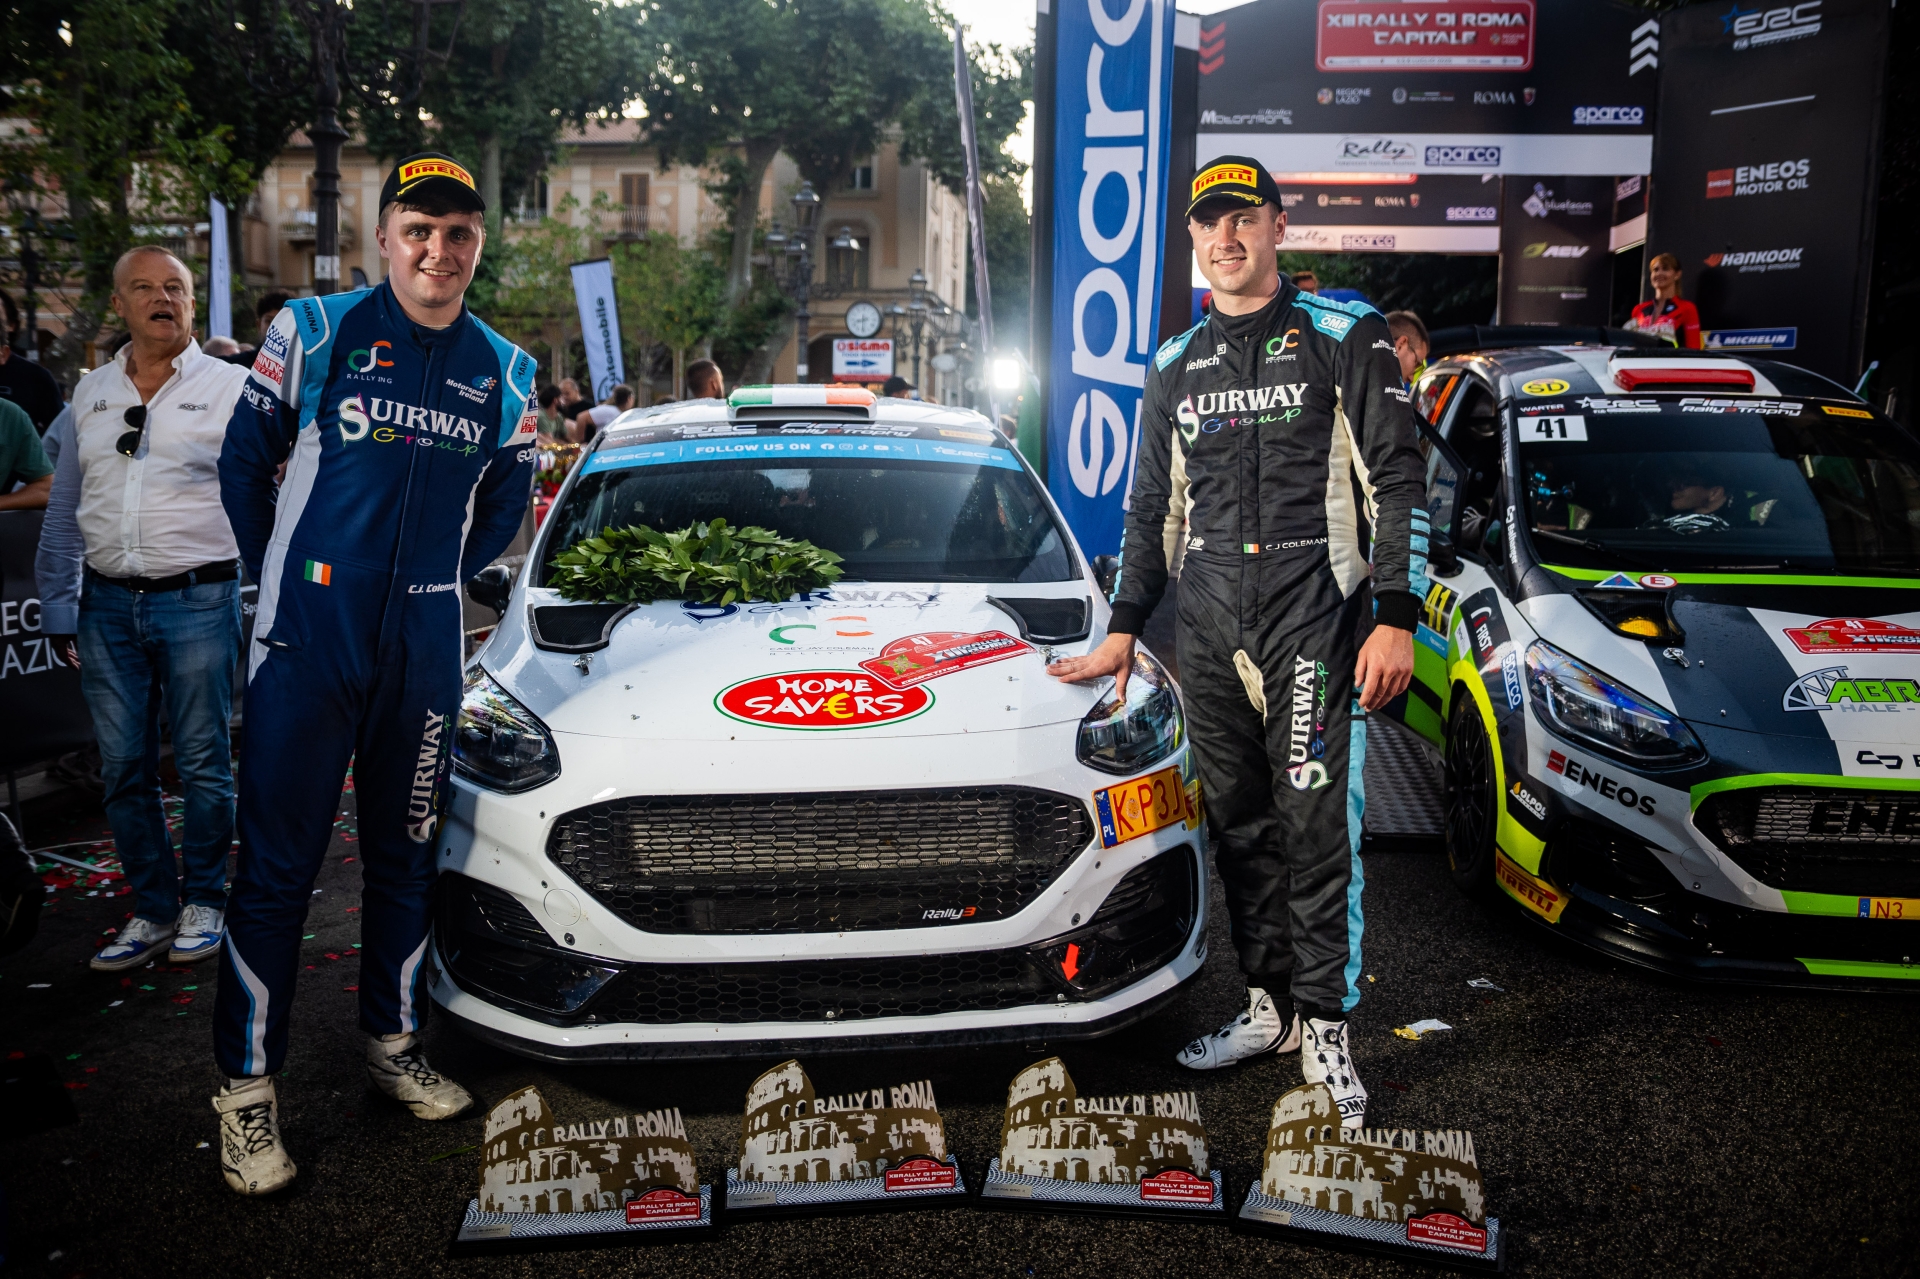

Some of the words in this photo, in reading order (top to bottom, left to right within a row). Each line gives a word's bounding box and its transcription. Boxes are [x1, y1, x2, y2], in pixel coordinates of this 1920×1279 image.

[1357, 13, 1430, 28] RALLY
[1436, 13, 1457, 27] DI
[1462, 13, 1526, 27] ROMA
[1373, 30, 1477, 46] CAPITALE
[1473, 91, 1515, 105] ROMA
[1573, 105, 1643, 126] sparco
[1343, 140, 1406, 160] Rally
[1425, 146, 1500, 166] sparco
[404, 163, 472, 187] PIRELLI
[1735, 159, 1811, 183] ENEOS
[1195, 171, 1253, 194] PIRELLI
[1735, 180, 1782, 197] MOTOR
[1786, 178, 1809, 190] OIL
[1374, 196, 1406, 207] ROMA
[1446, 206, 1498, 221] sparco
[1320, 316, 1349, 331] OMP
[1723, 334, 1789, 346] MICHELIN
[1157, 343, 1183, 364] OMP
[347, 373, 393, 386] RALLYING
[446, 378, 490, 399] Motorsport
[1527, 382, 1564, 394] SD
[458, 389, 488, 405] Ireland
[1679, 397, 1804, 410] Fiesta
[1176, 383, 1309, 448] SUIRWAY
[1519, 403, 1565, 414] WARTER
[1740, 407, 1801, 418] Trophy
[338, 392, 487, 448] SUIRWAY
[780, 421, 919, 433] Fiesta
[1201, 408, 1302, 434] Group
[1536, 418, 1568, 439] 41
[373, 427, 479, 457] Group
[607, 432, 655, 442] WARTER
[844, 428, 915, 438] Trophy
[694, 444, 759, 454] FOLLOW
[764, 443, 785, 452] US
[789, 442, 811, 451] ON
[1281, 537, 1328, 551] COLEMAN
[1650, 577, 1666, 587] E
[1845, 620, 1865, 630] 41
[1475, 624, 1493, 652] FIRST
[776, 677, 855, 695] HOME
[1502, 653, 1522, 708] sparco
[1826, 678, 1920, 704] ABR
[1311, 662, 1329, 758] Group
[1840, 704, 1901, 714] HALE
[1286, 654, 1333, 791] SUIRWAY
[432, 714, 451, 811] Group
[405, 708, 445, 845] SUIRWAY
[1564, 763, 1657, 816] ENEOS
[1519, 789, 1547, 817] OLPOL
[1103, 825, 1116, 838] PL
[1497, 855, 1559, 913] PIRELLI
[922, 905, 968, 921] Rally3
[1875, 901, 1903, 919] N3
[814, 1091, 867, 1115] RALLY
[871, 1089, 884, 1110] DI
[890, 1079, 941, 1113] ROMA
[1075, 1096, 1131, 1116] RALLY
[1133, 1095, 1146, 1116] DI
[1152, 1092, 1202, 1127] ROMA
[553, 1120, 612, 1143] RALLY
[615, 1116, 629, 1138] DI
[634, 1106, 688, 1141] ROMA
[1339, 1131, 1399, 1151] RALLY
[1402, 1132, 1416, 1153] DI
[1423, 1134, 1479, 1170] ROMA
[1422, 1224, 1448, 1233] RALLY
[1459, 1230, 1483, 1239] ROMA
[1428, 1230, 1465, 1241] CAPITALE
